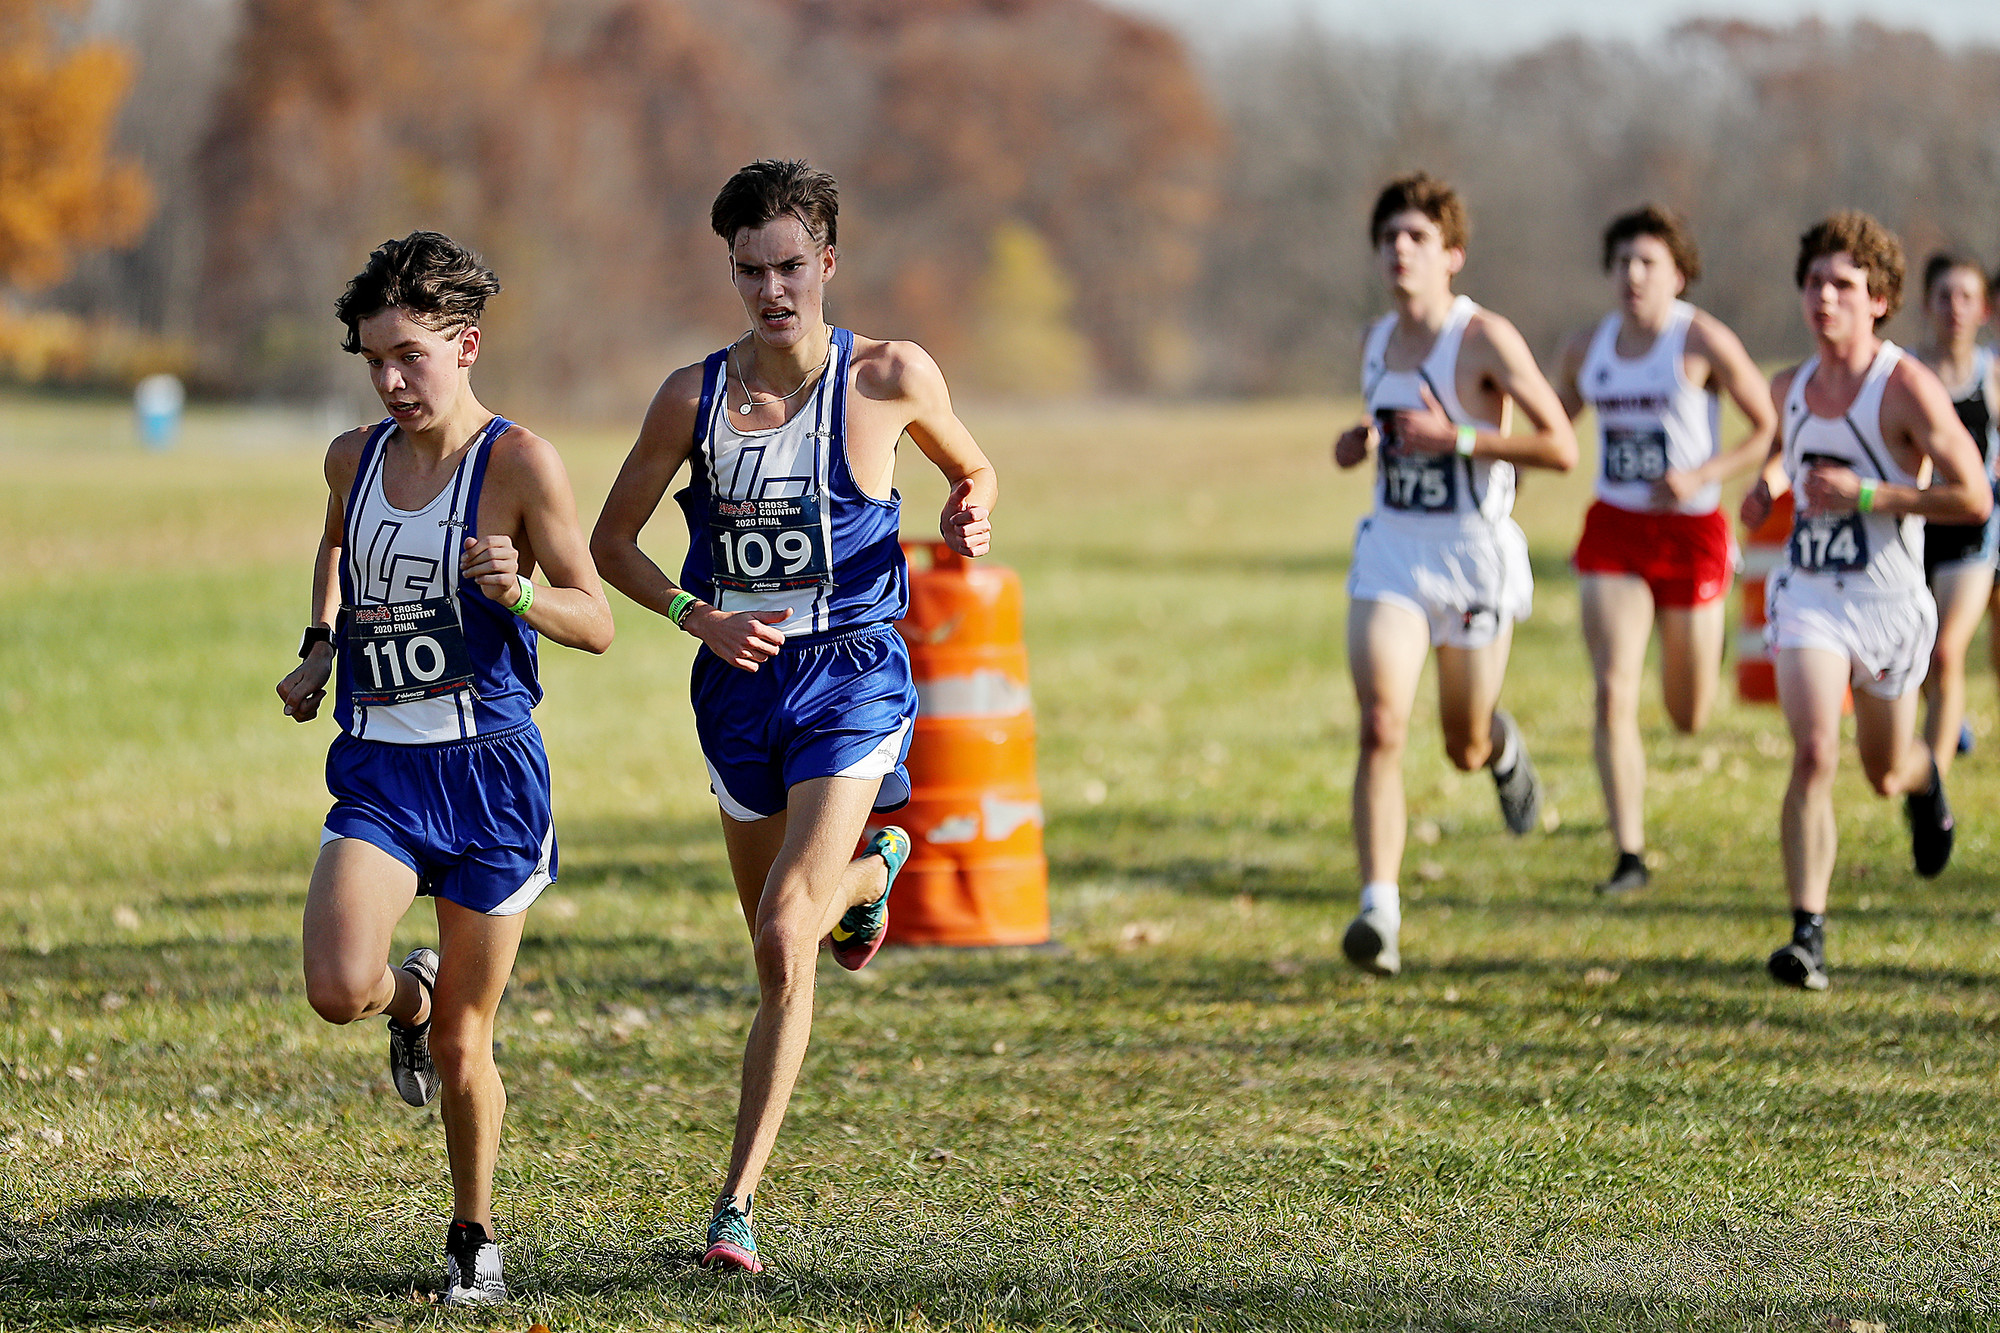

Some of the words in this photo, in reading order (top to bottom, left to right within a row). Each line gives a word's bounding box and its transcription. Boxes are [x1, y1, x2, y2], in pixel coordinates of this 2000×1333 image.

[1387, 465, 1448, 508] 175
[758, 501, 789, 509] CROSS
[760, 507, 801, 516] COUNTRY
[735, 519, 756, 528] 2020
[758, 517, 782, 526] FINAL
[1796, 525, 1859, 568] 174
[720, 530, 812, 577] 109
[393, 603, 423, 614] CROSS
[394, 609, 436, 622] COUNTRY
[373, 624, 393, 634] 2020
[393, 622, 418, 633] FINAL
[363, 635, 446, 688] 110
